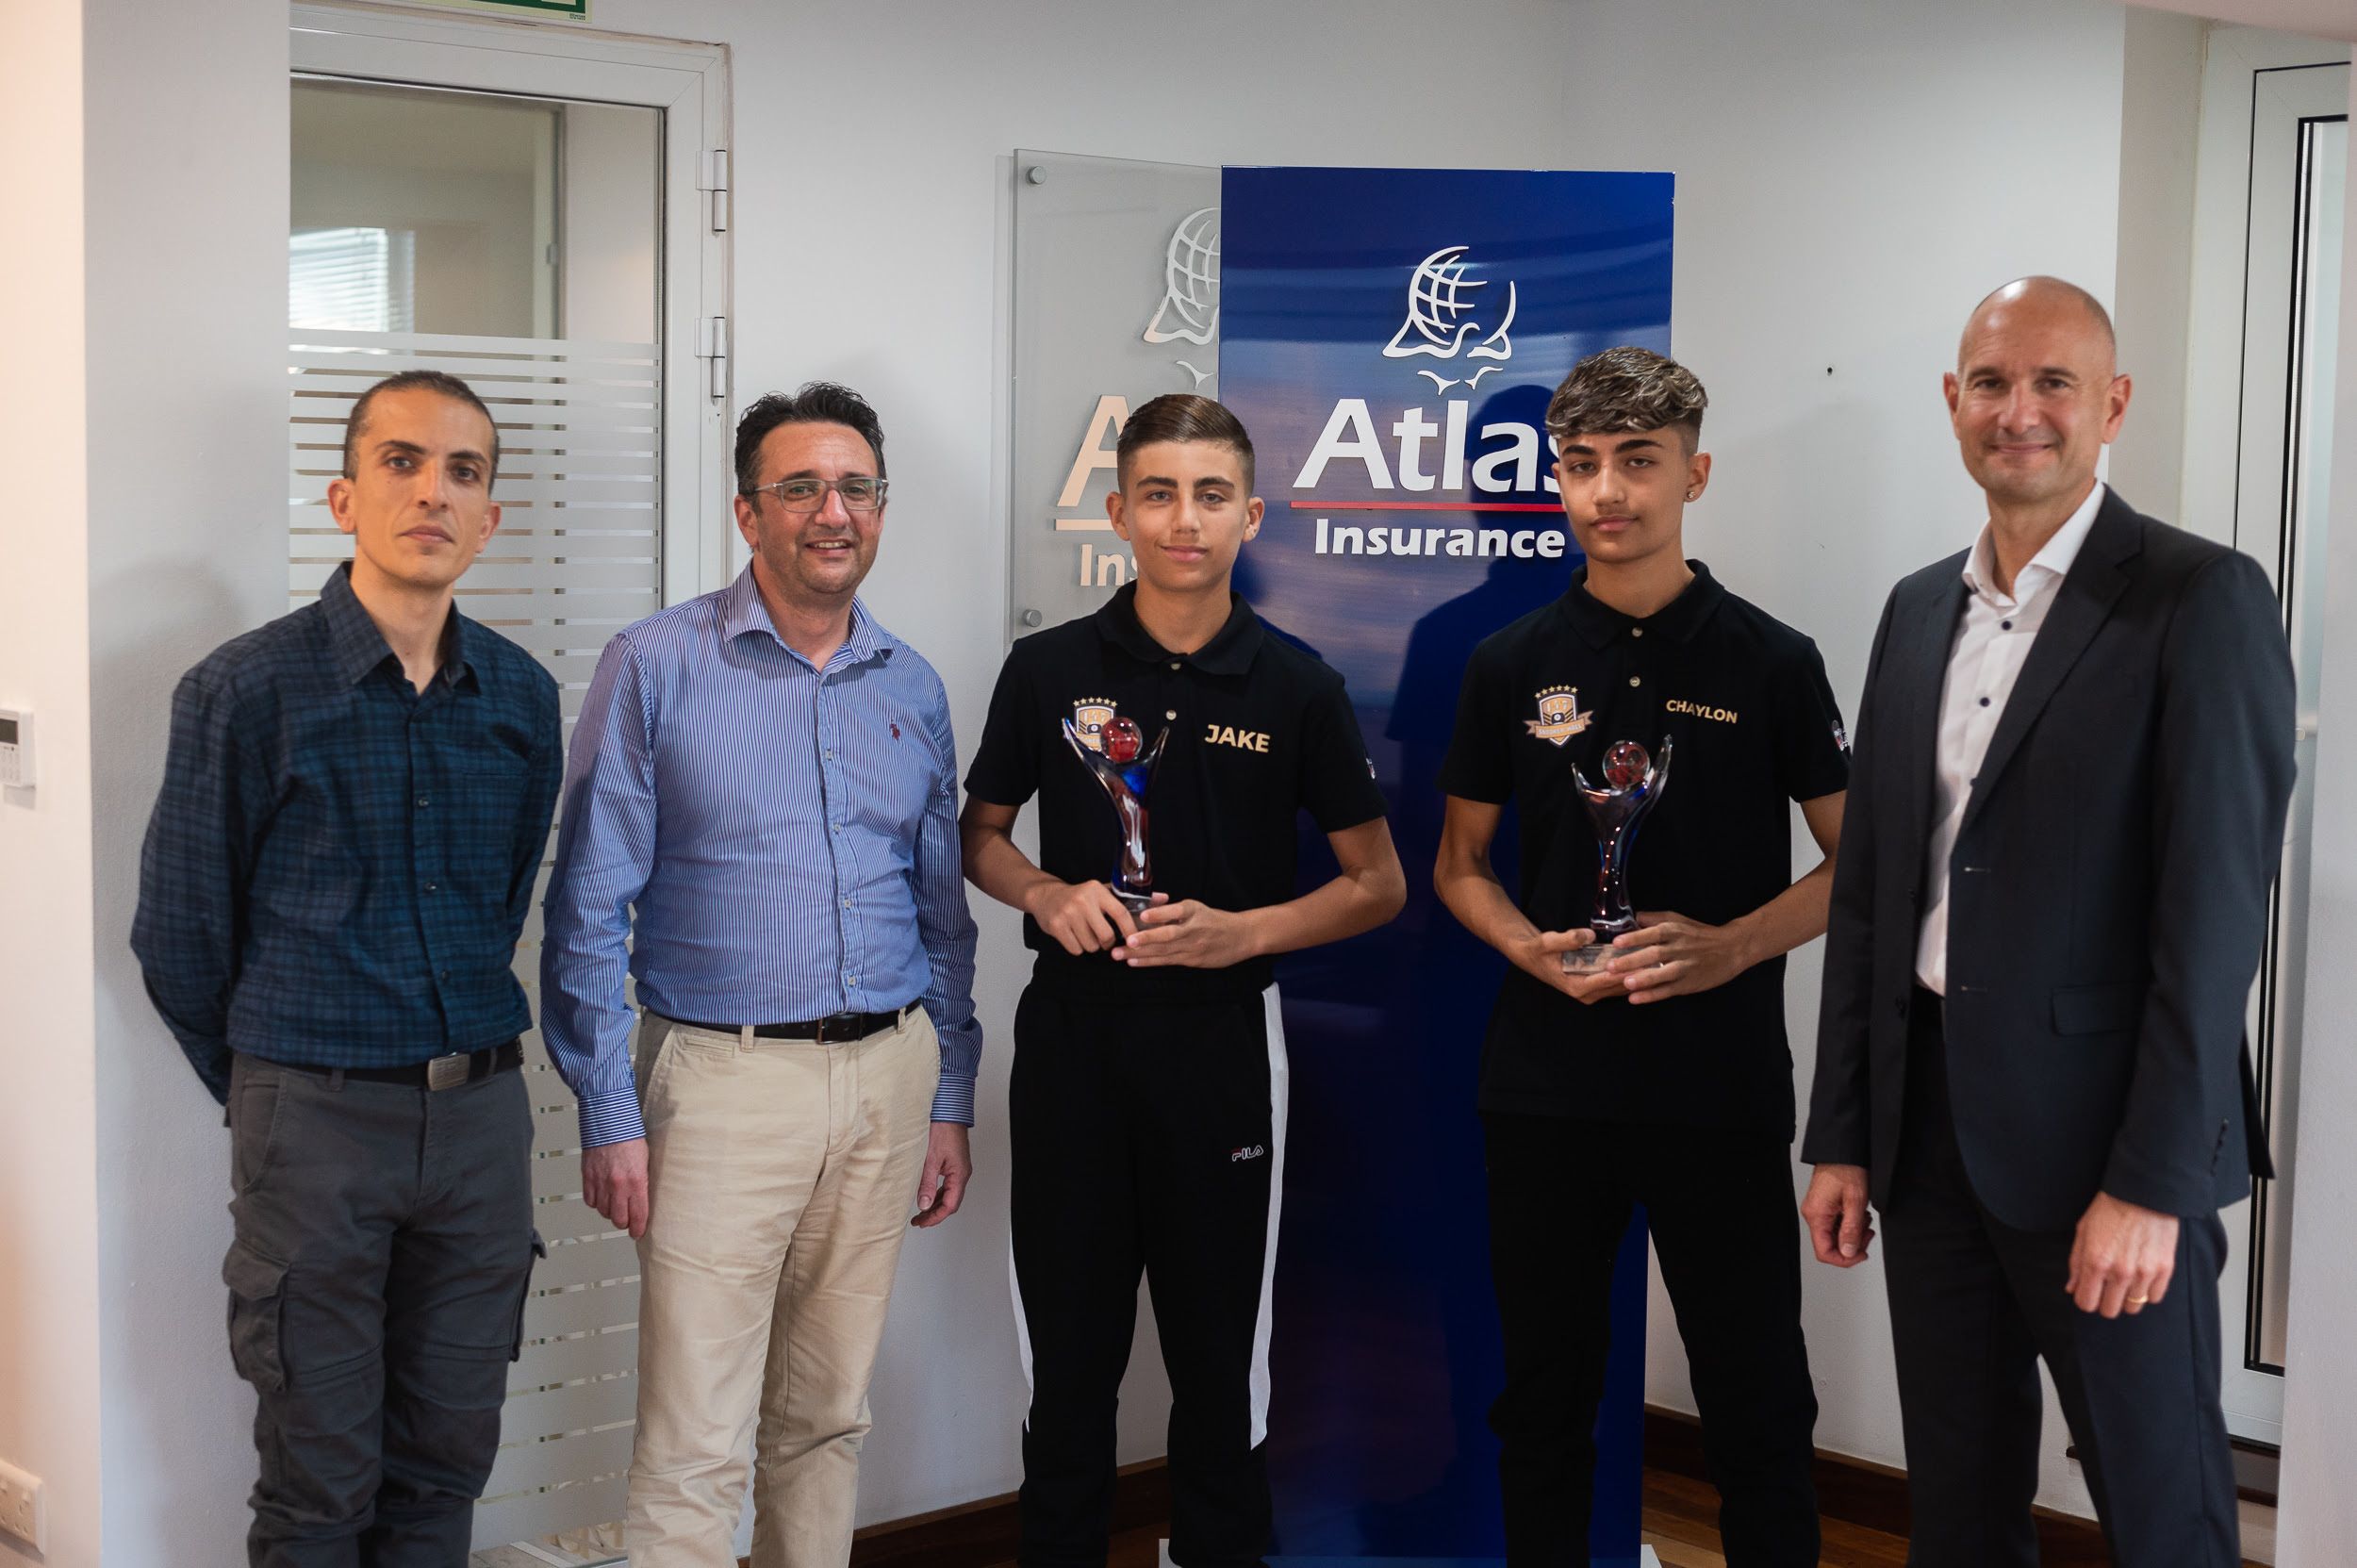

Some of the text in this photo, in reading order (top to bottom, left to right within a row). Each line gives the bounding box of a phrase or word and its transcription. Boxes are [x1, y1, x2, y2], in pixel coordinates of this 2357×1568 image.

[1315, 519, 1566, 558] Insurance
[1546, 700, 1569, 713] 147
[1666, 700, 1738, 724] CHAYLON
[1083, 710, 1107, 722] 147
[1538, 723, 1583, 735] SNOOKER HALL
[1204, 724, 1270, 753] JAKE
[1231, 1145, 1264, 1162] FILA
